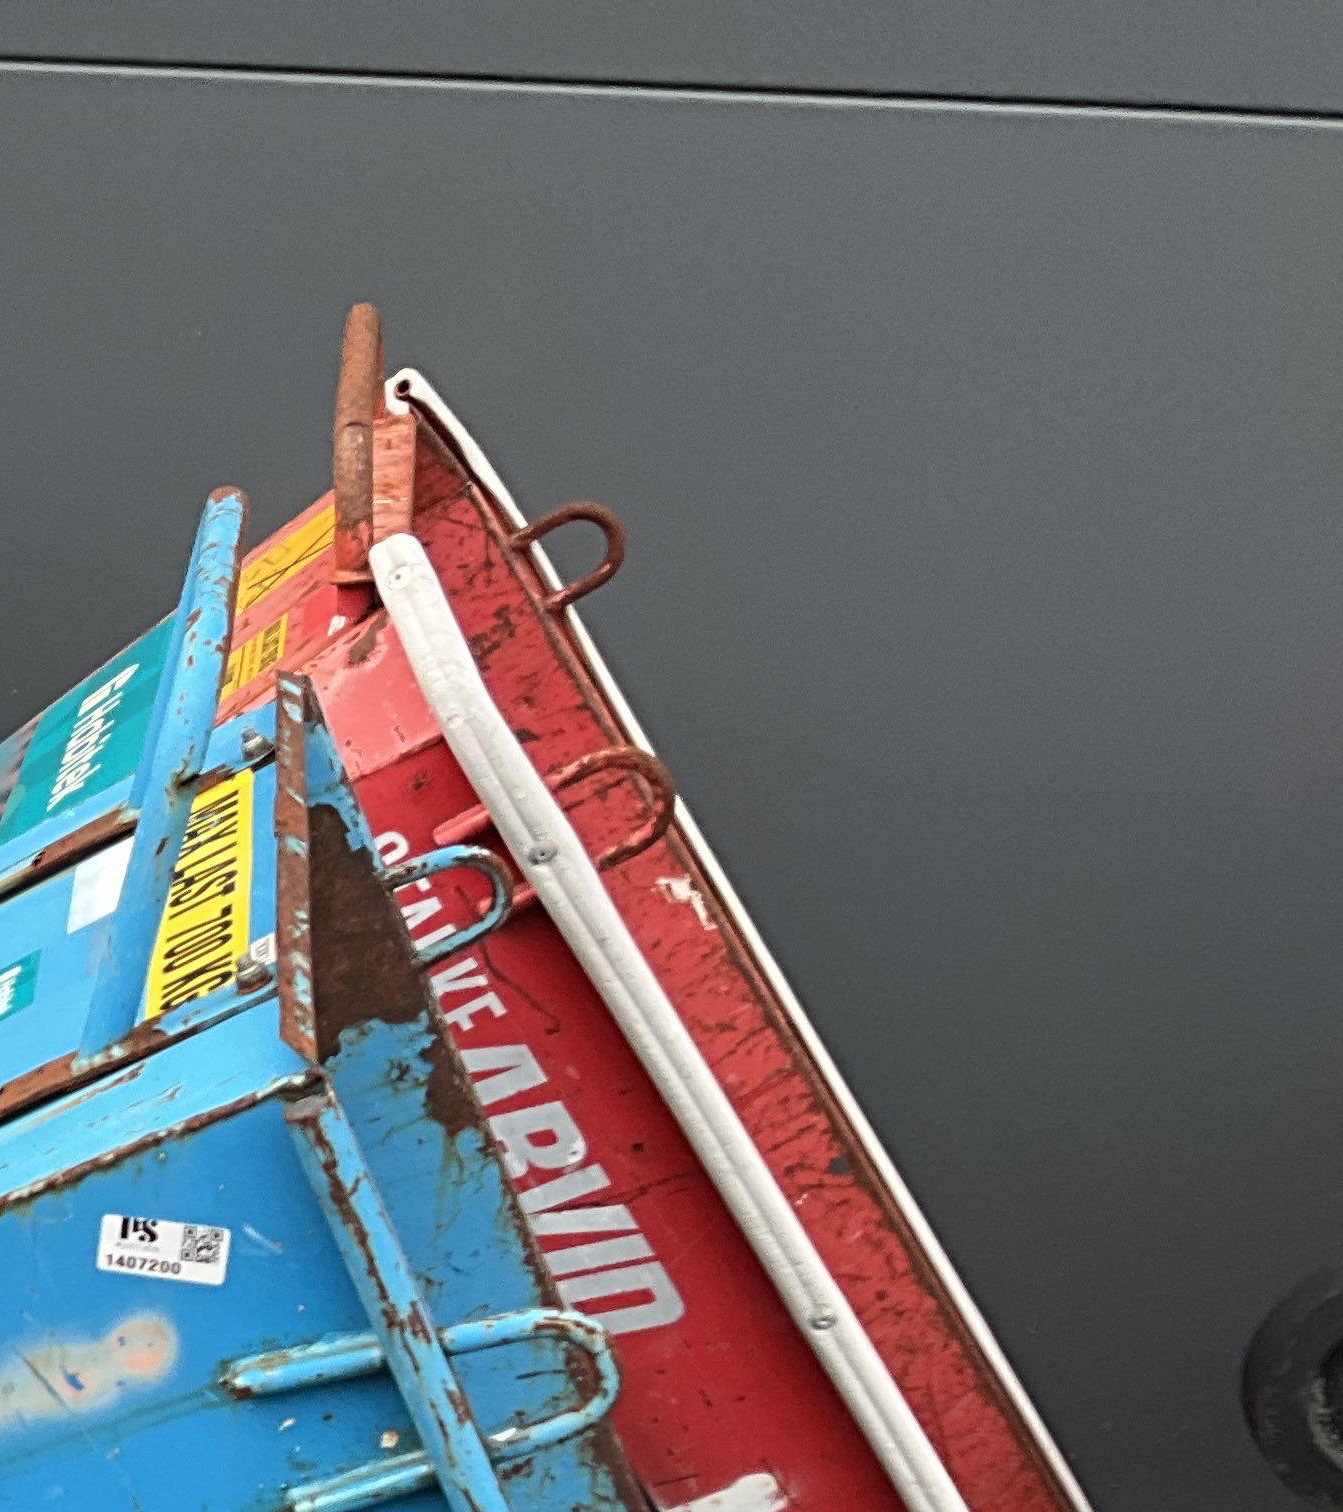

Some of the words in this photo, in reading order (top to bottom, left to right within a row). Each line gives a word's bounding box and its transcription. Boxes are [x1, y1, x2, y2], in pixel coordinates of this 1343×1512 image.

[179, 788, 239, 861] MAX
[168, 841, 238, 921] LAST
[163, 903, 234, 975] 700
[159, 950, 234, 1012] KG
[459, 1043, 686, 1337] ARVID
[105, 1253, 183, 1276] 1407200
